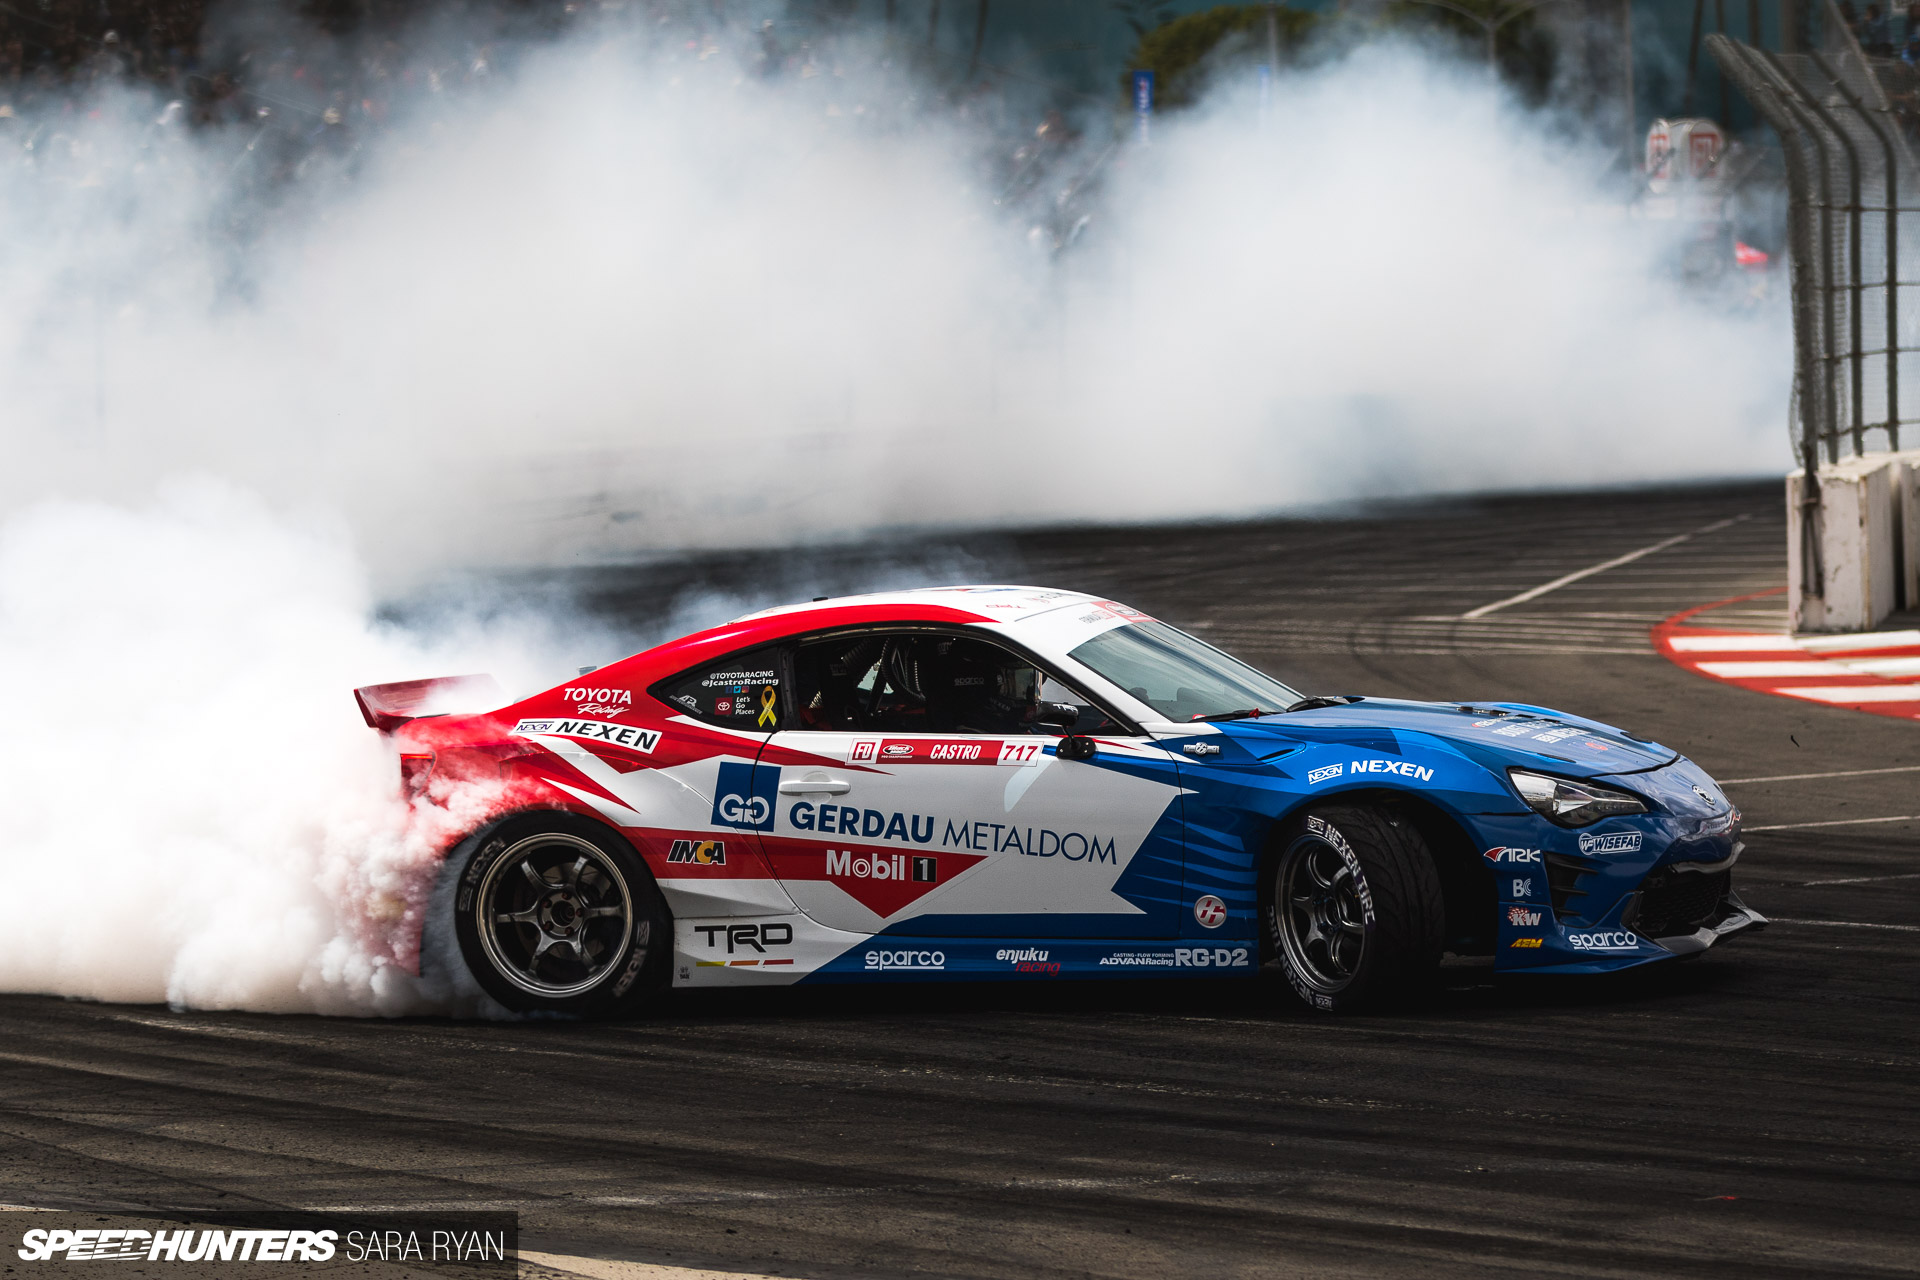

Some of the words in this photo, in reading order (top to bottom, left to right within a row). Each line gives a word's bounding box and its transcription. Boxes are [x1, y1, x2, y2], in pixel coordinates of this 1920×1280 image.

[709, 670, 775, 680] @TOYOTARACING
[563, 687, 633, 705] TOYOTA
[577, 702, 630, 719] Racing
[555, 721, 658, 751] NEXEN
[930, 744, 982, 760] CASTRO
[1002, 744, 1039, 762] 717
[1350, 760, 1435, 782] NEXEN
[789, 801, 935, 844] GERDAU
[942, 818, 1118, 866] METALDOM
[1594, 835, 1641, 851] WISEFAB
[826, 849, 905, 881] Mobil
[1511, 912, 1542, 926] KW
[694, 923, 794, 954] TRD
[1569, 931, 1638, 950] sparco
[864, 950, 945, 971] sparco
[995, 947, 1049, 964] enjuku
[1174, 948, 1249, 967] RG-D2
[1015, 961, 1061, 977] racing
